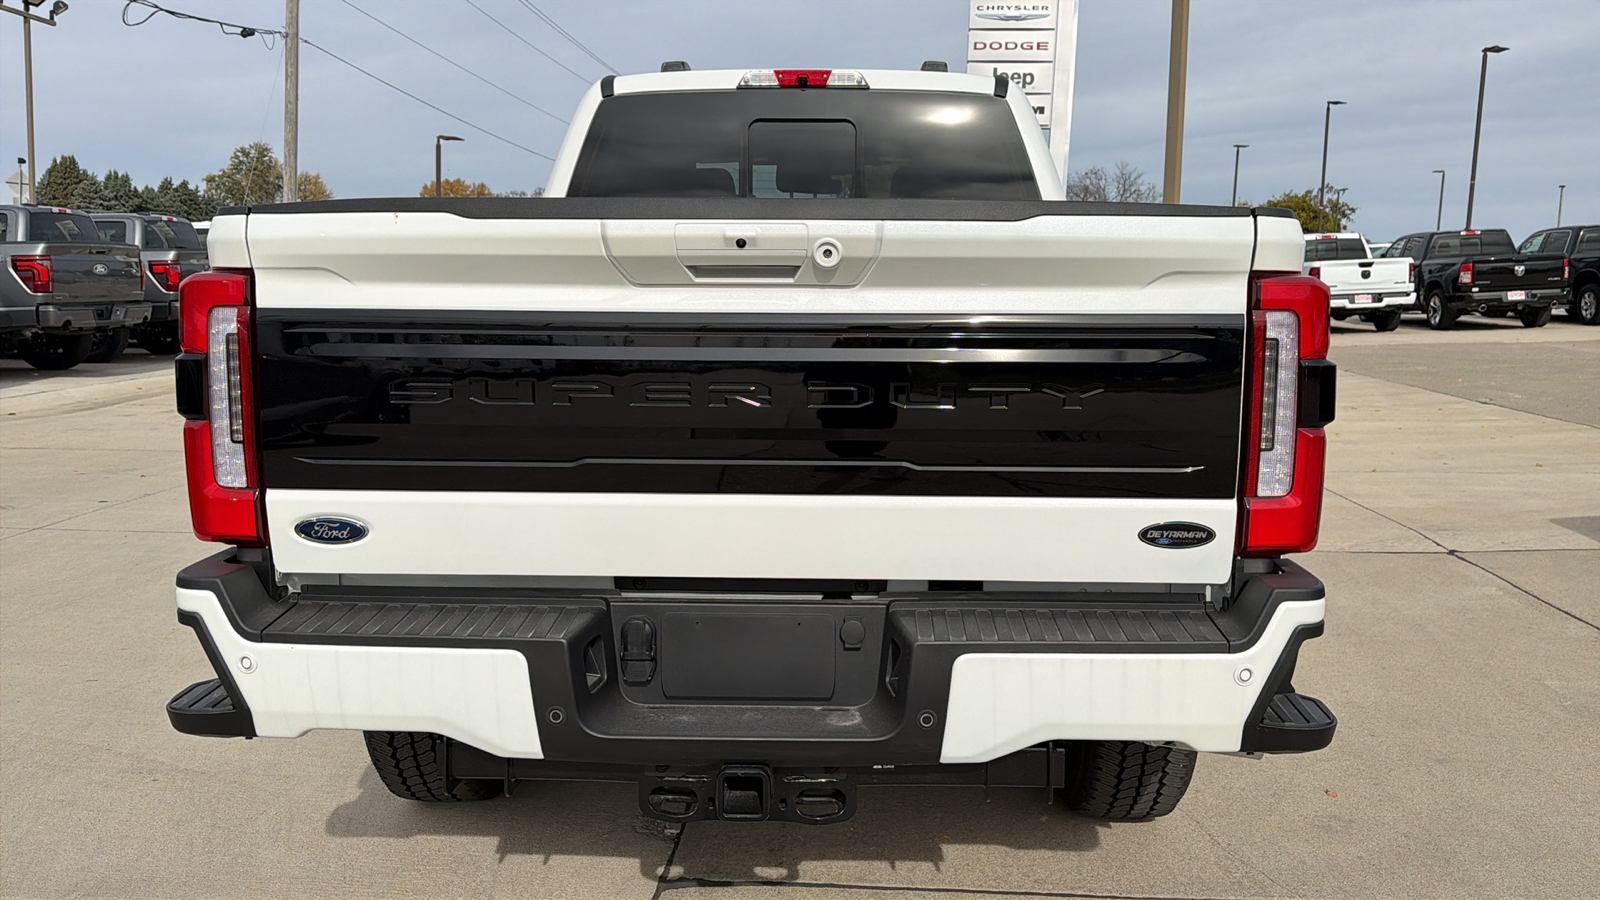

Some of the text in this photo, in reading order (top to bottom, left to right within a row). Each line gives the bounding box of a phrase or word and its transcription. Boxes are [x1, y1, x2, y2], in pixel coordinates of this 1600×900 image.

[973, 41, 1049, 51] DODGE
[389, 378, 1105, 410] SUPER DUTY
[311, 522, 350, 538] Ford
[1147, 530, 1207, 539] DEYARMAN
